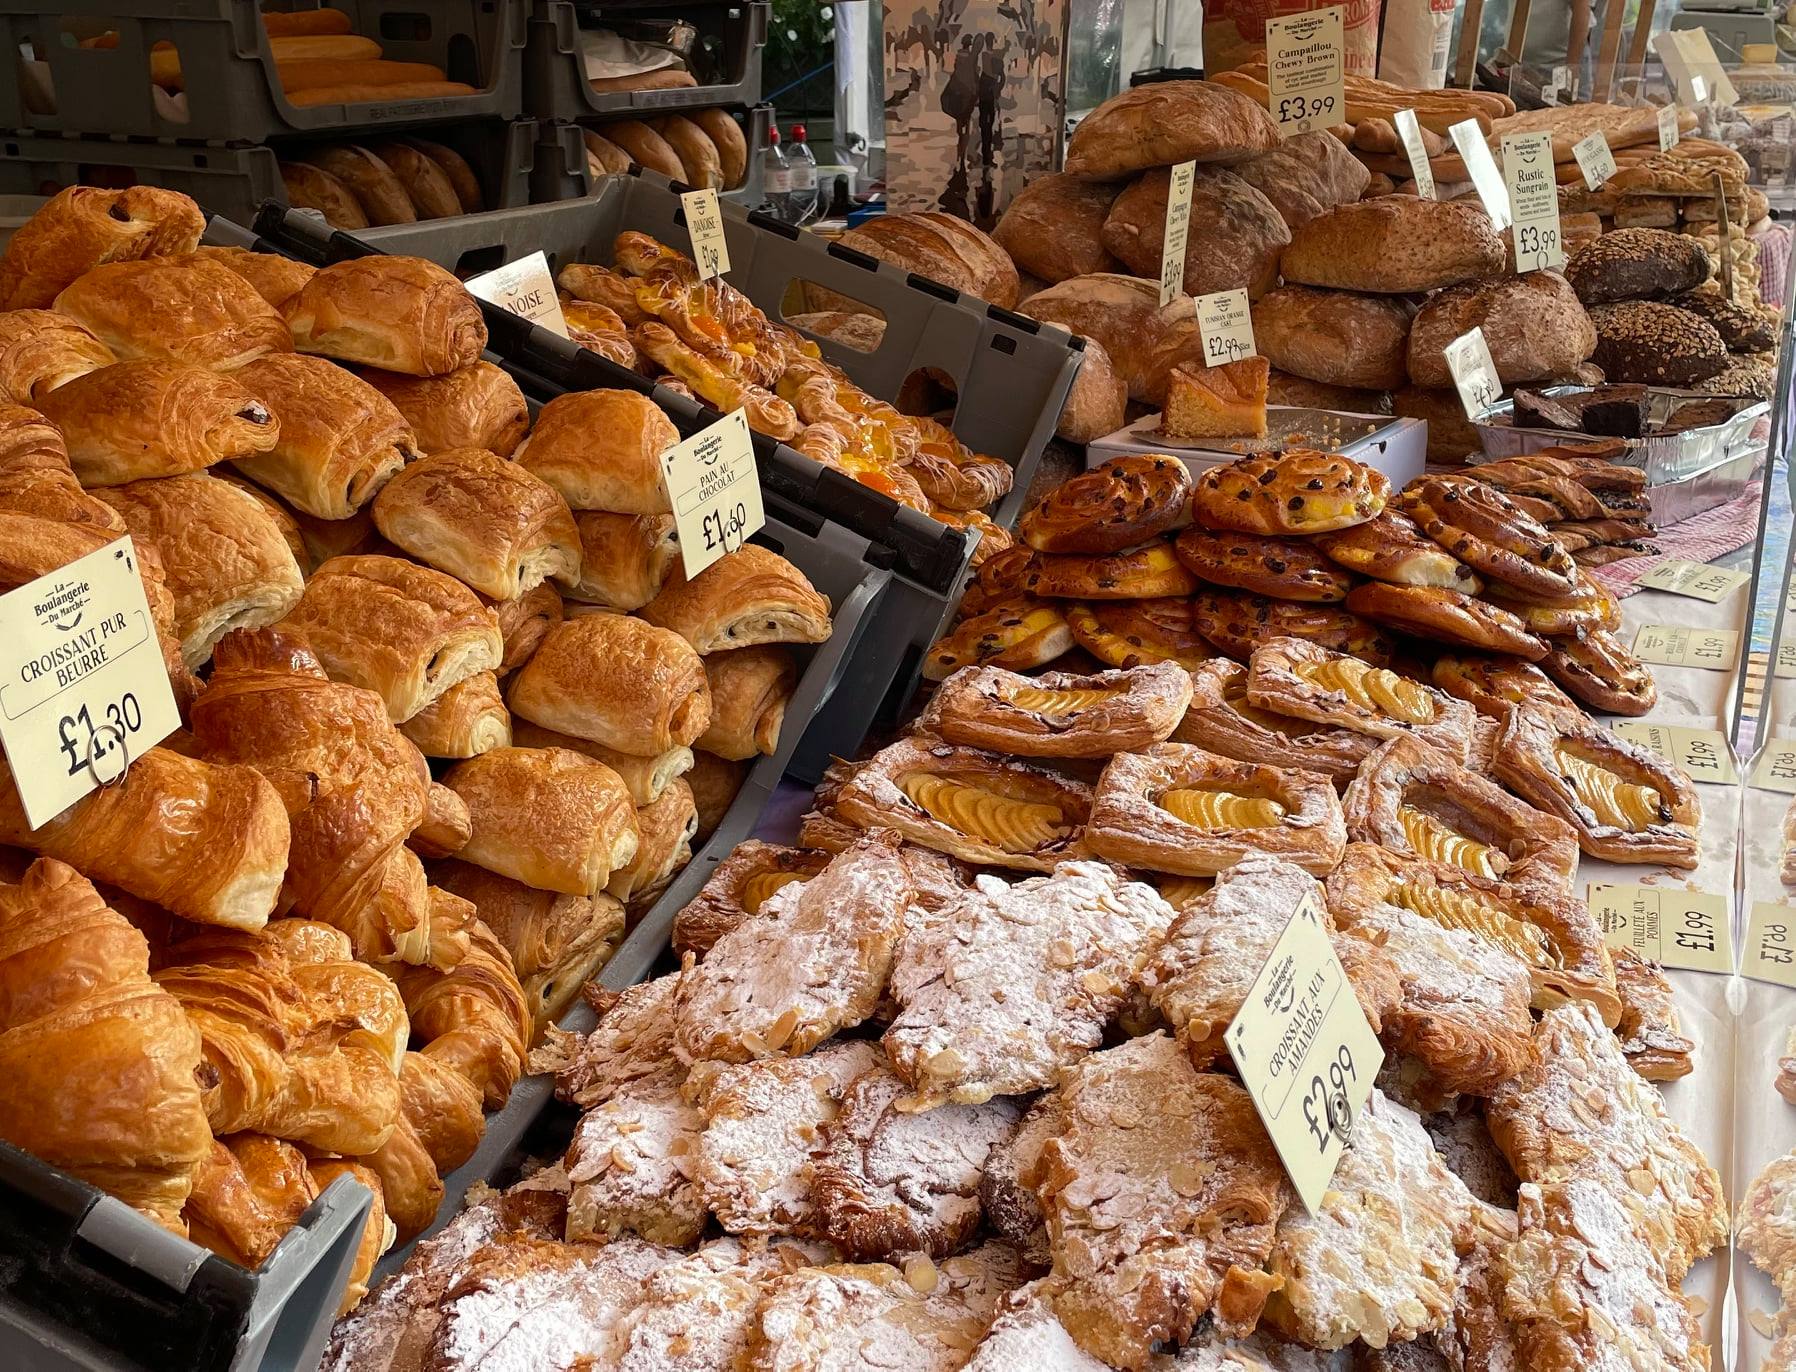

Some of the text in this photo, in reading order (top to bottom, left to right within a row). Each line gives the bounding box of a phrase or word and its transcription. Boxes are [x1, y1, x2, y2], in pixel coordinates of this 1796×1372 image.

[1275, 53, 1335, 70] Chewy Brown
[1278, 42, 1332, 59] Campaillou
[1278, 96, 1335, 123] £3.99
[1516, 181, 1549, 195] Sungrain
[1517, 168, 1544, 182] Rustic
[693, 217, 716, 233] DANOISE
[1520, 226, 1556, 254] £3.99
[502, 289, 544, 315] NOISE
[1209, 336, 1238, 357] £2.99
[693, 434, 722, 457] Boulangerie
[699, 470, 736, 501] CHOCOLAT
[700, 462, 729, 488] PAIN AU
[703, 502, 746, 551] £1.60
[34, 581, 90, 617] Boulangerie
[54, 583, 65, 593] La
[49, 599, 84, 624] Du Marché
[21, 612, 127, 683] CROISSANT PUR
[1695, 638, 1724, 658] £1.99
[56, 644, 109, 687] BEURRE
[58, 692, 142, 776] £1.30
[1686, 741, 1718, 769] £1.99
[1633, 900, 1645, 914] AUX
[1646, 911, 1658, 940] POMMES
[1674, 911, 1715, 951] £1.99
[1263, 955, 1295, 1008] Boulangerie
[1269, 969, 1326, 1078] CROISSANT AUX
[1288, 1003, 1324, 1077] AMANDES
[1303, 1044, 1357, 1154] £2.99
